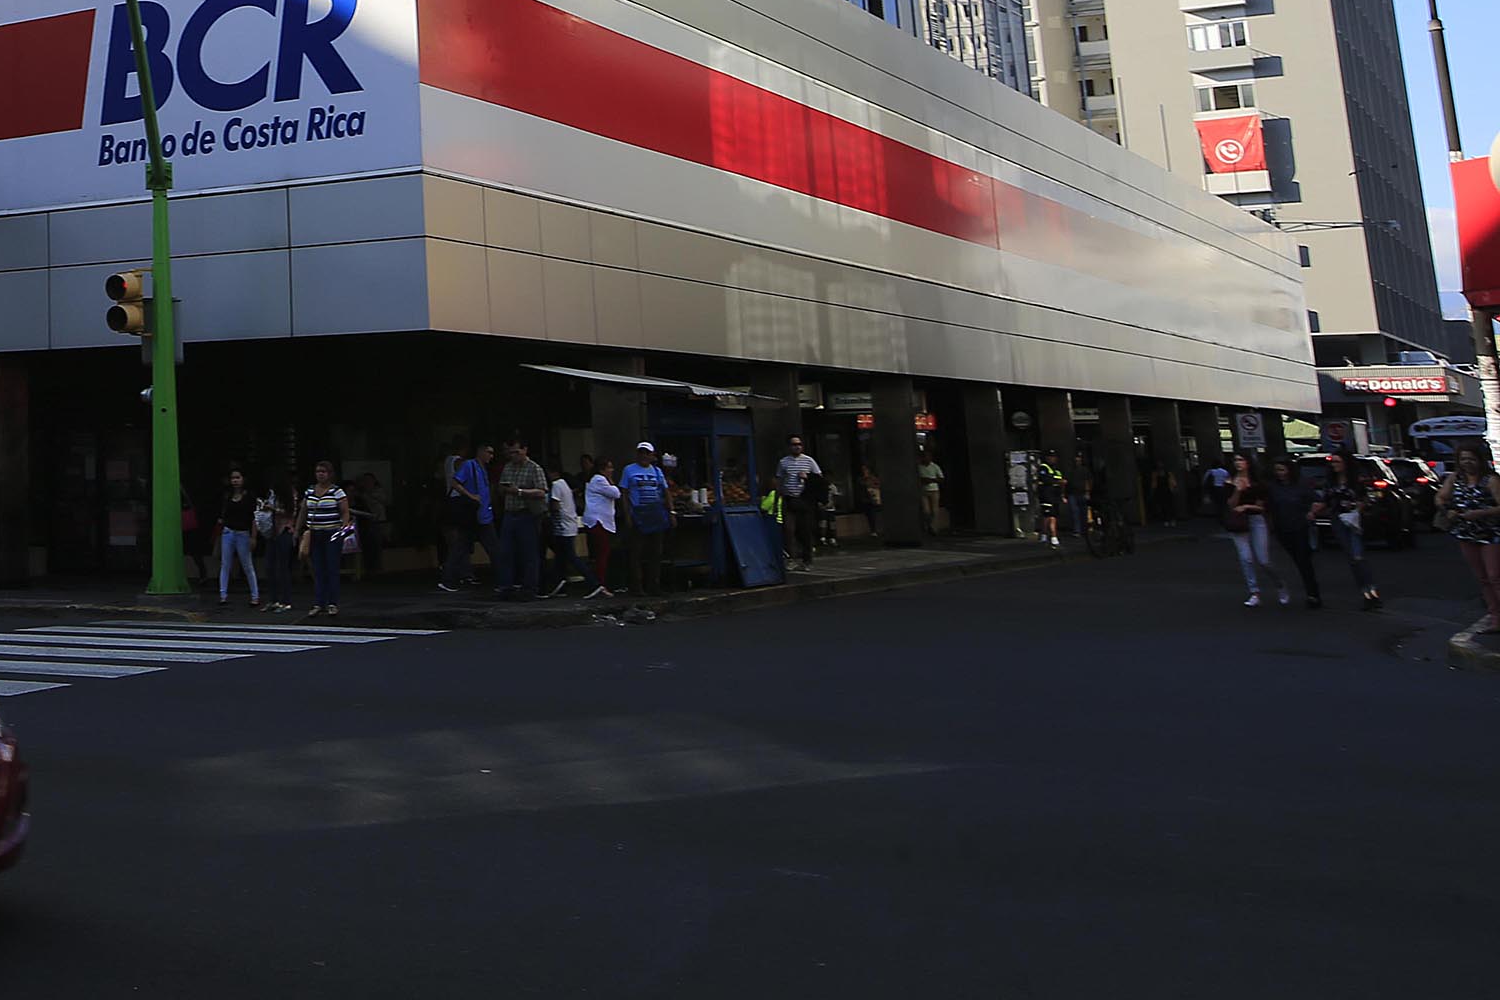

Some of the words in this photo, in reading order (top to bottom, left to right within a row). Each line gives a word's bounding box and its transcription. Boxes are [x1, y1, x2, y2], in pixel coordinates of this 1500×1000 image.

[98, 134, 177, 166] Bano
[181, 121, 216, 156] de
[222, 115, 299, 151] Costa
[306, 105, 366, 142] Rica
[1345, 379, 1441, 391] McDonald's
